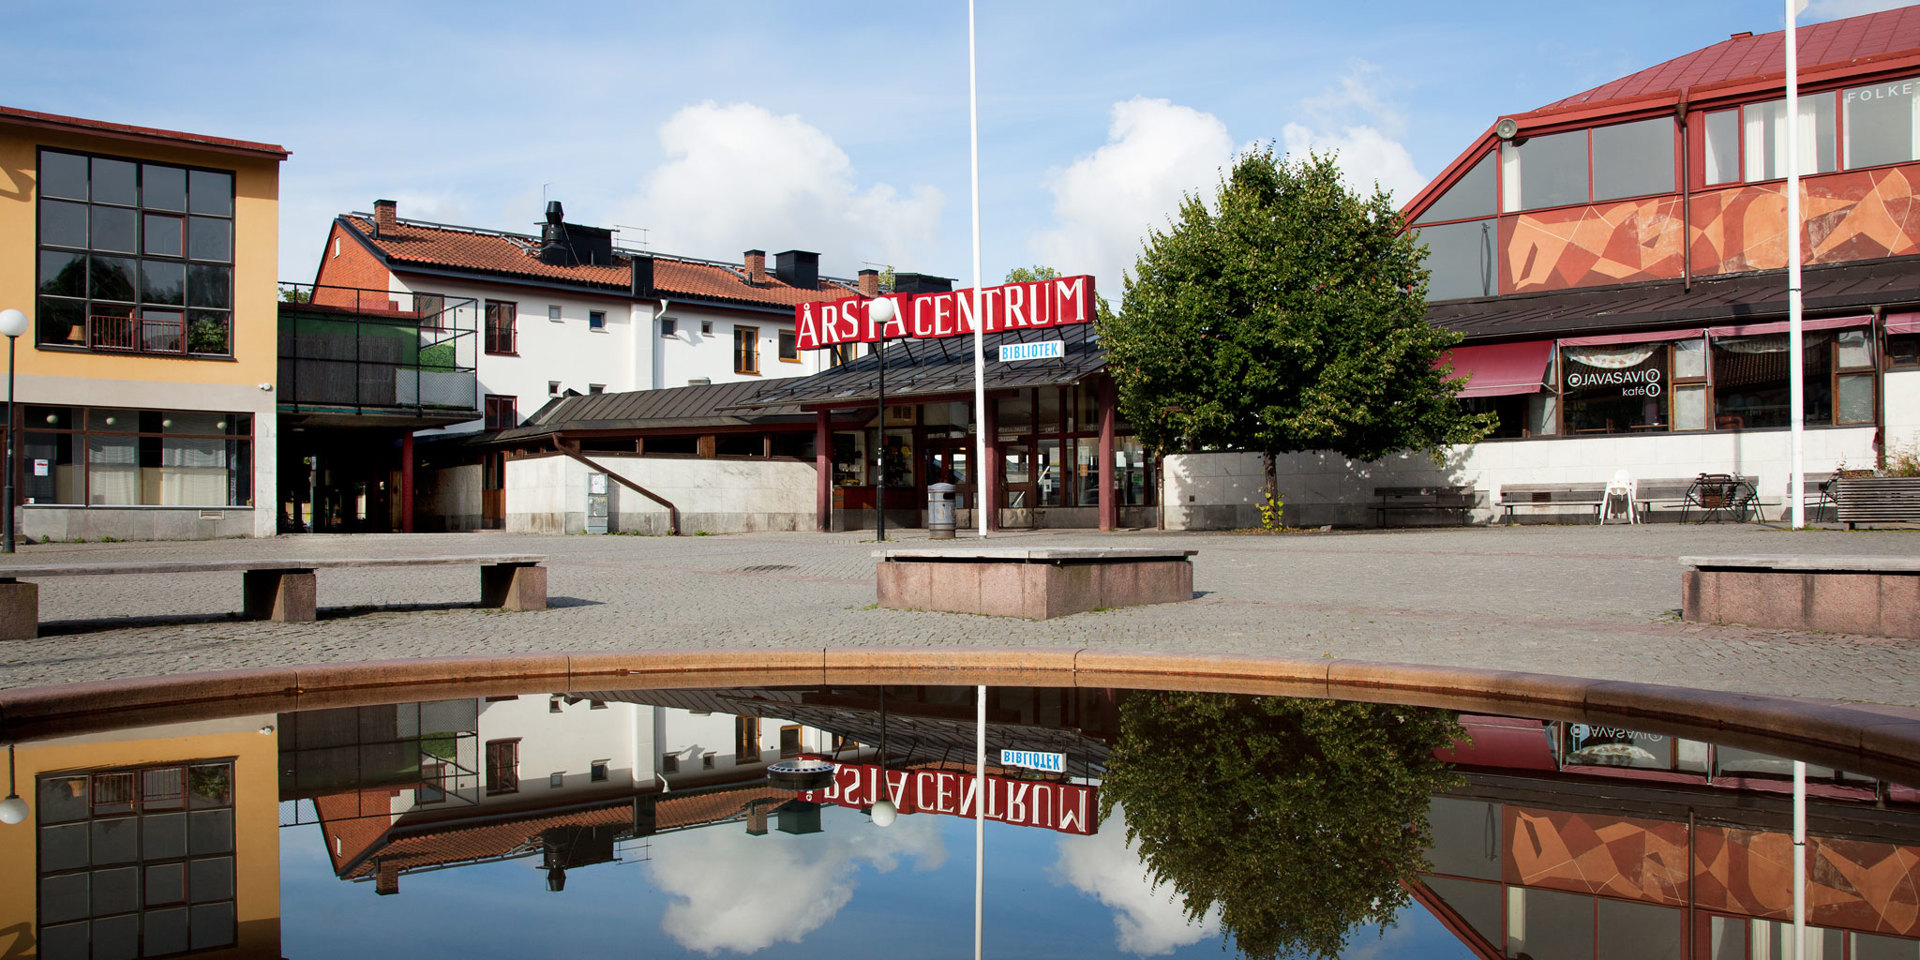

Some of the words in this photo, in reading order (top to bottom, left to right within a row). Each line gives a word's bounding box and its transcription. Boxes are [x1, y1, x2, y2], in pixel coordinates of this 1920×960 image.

[797, 297, 907, 348] ÅRSTA
[914, 278, 1086, 336] CENTRUM
[1002, 342, 1059, 360] BIBLIOTEK
[1622, 386, 1645, 397] kafé
